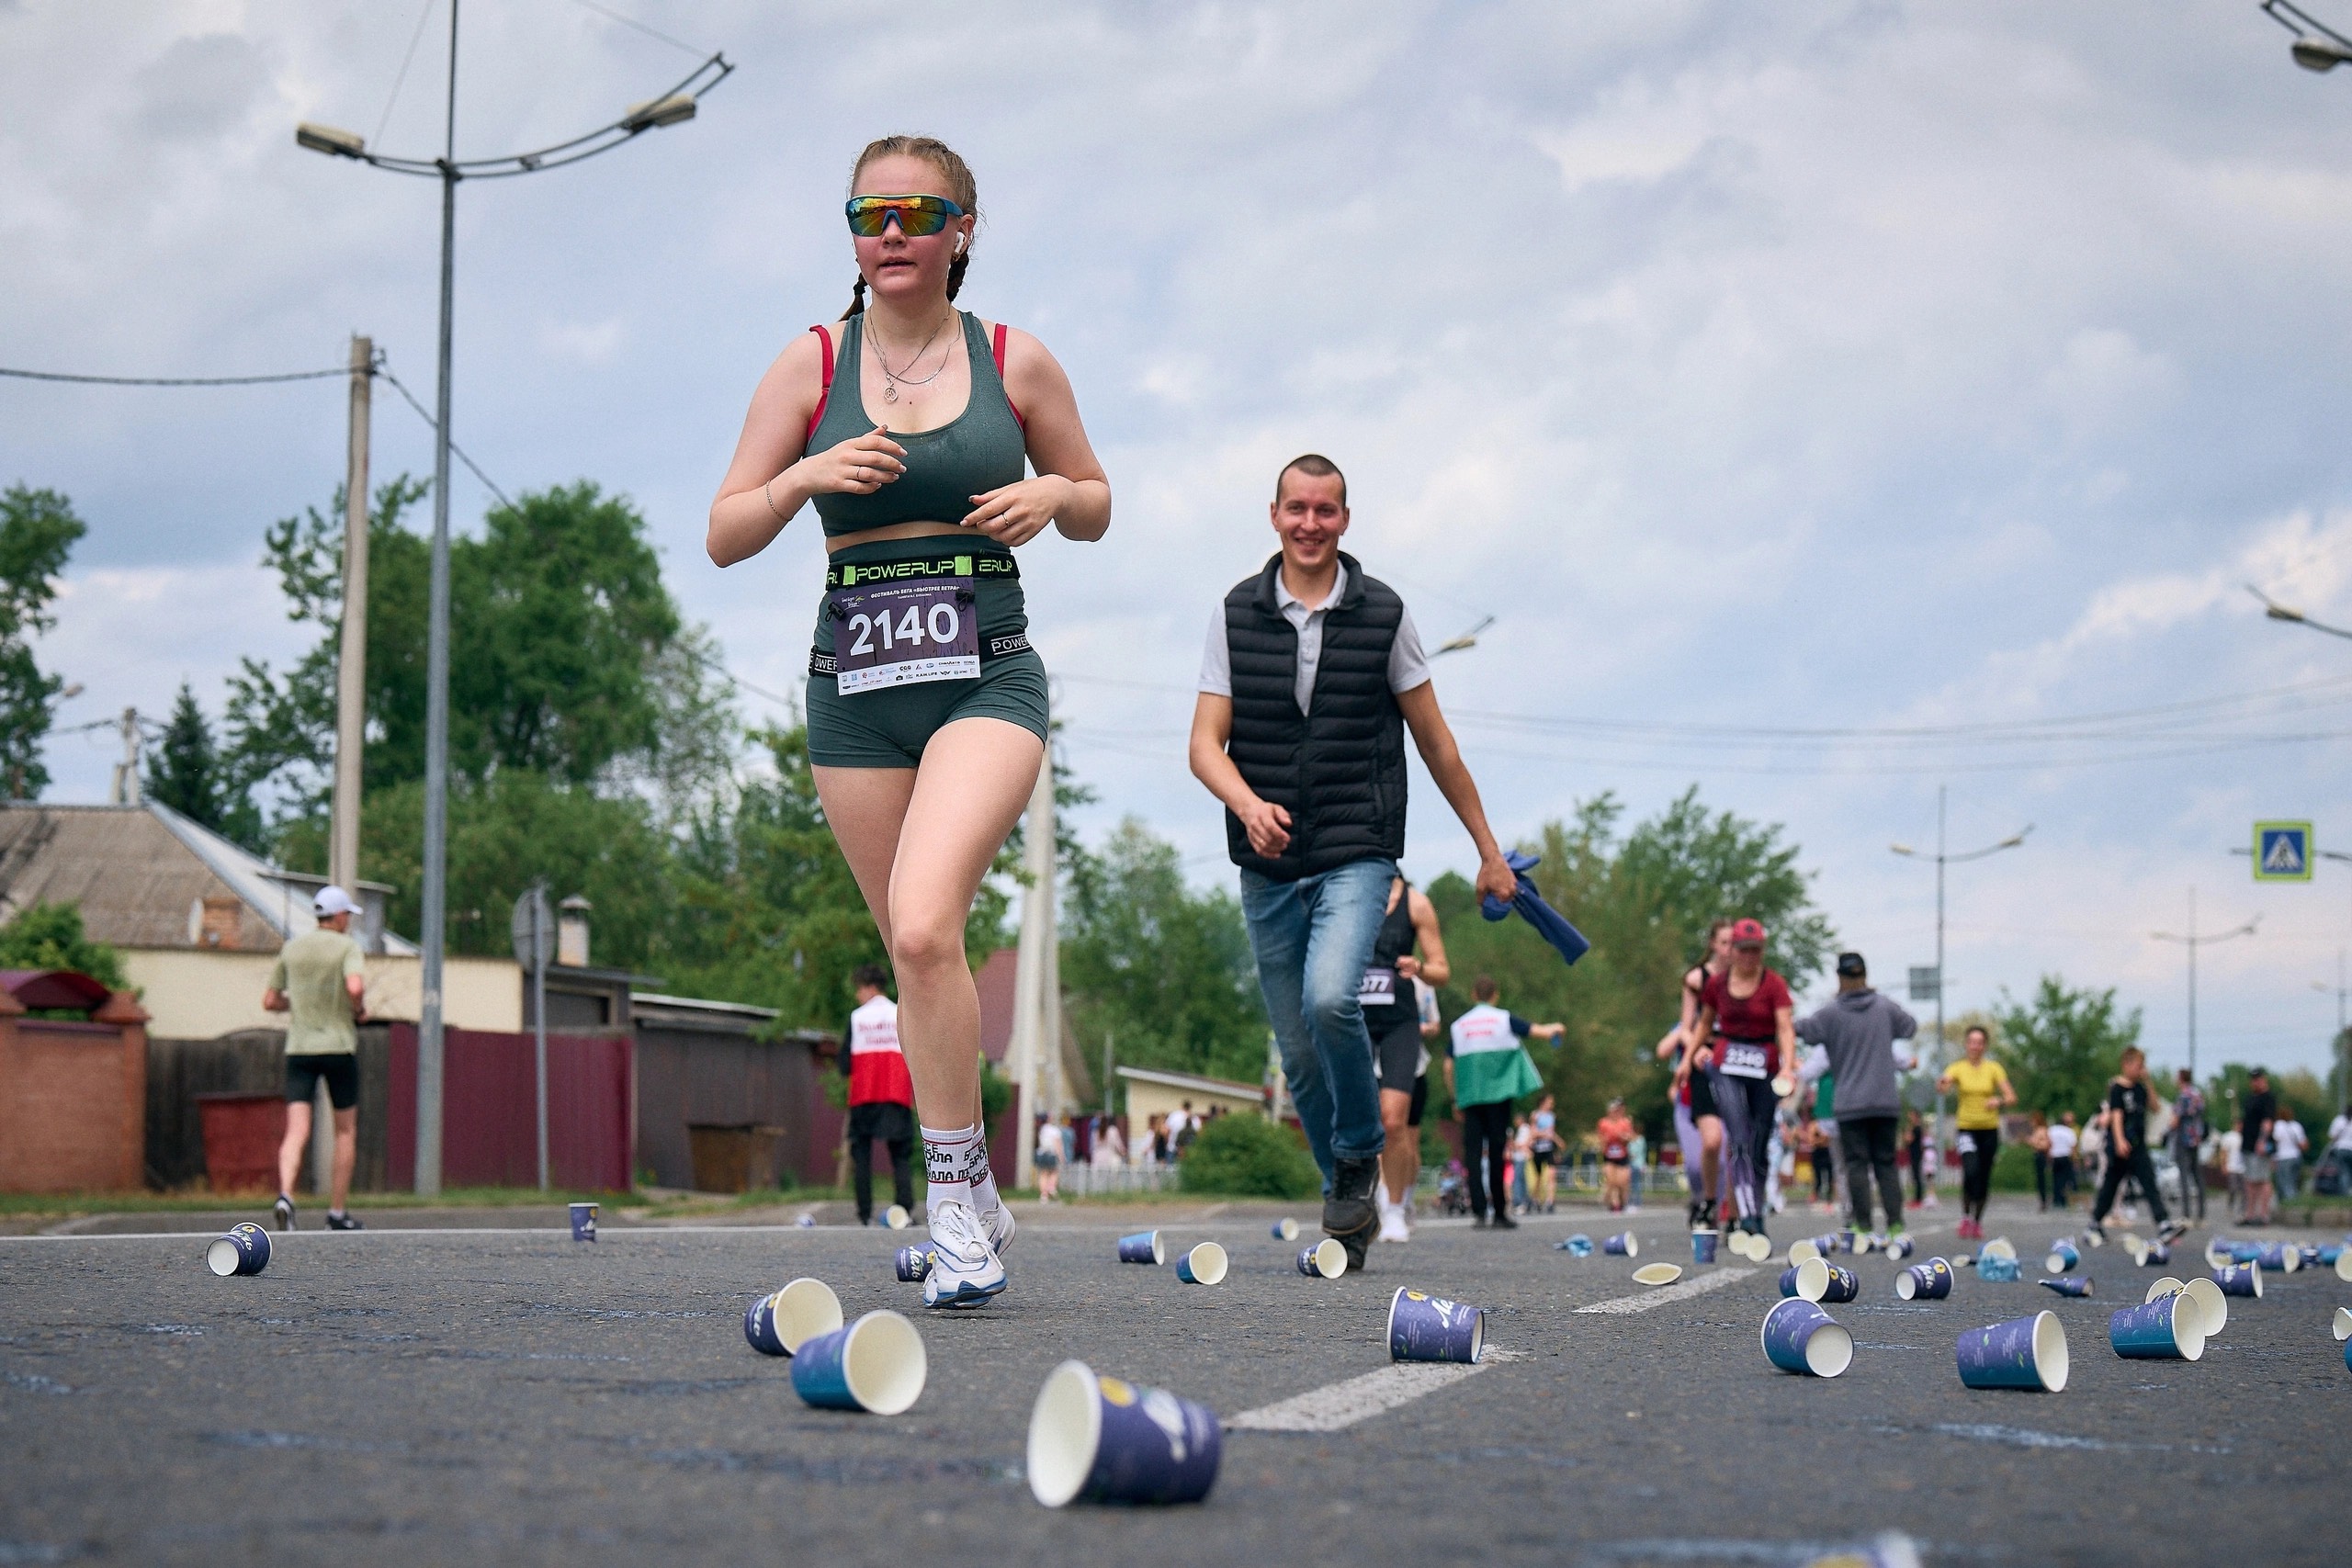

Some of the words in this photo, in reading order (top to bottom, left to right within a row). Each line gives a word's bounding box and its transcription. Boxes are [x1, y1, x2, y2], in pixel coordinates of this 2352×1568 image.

[856, 560, 955, 581] POWERUP
[870, 590, 900, 599] ФЕСТИВАЛЬ
[848, 603, 959, 657] 2140
